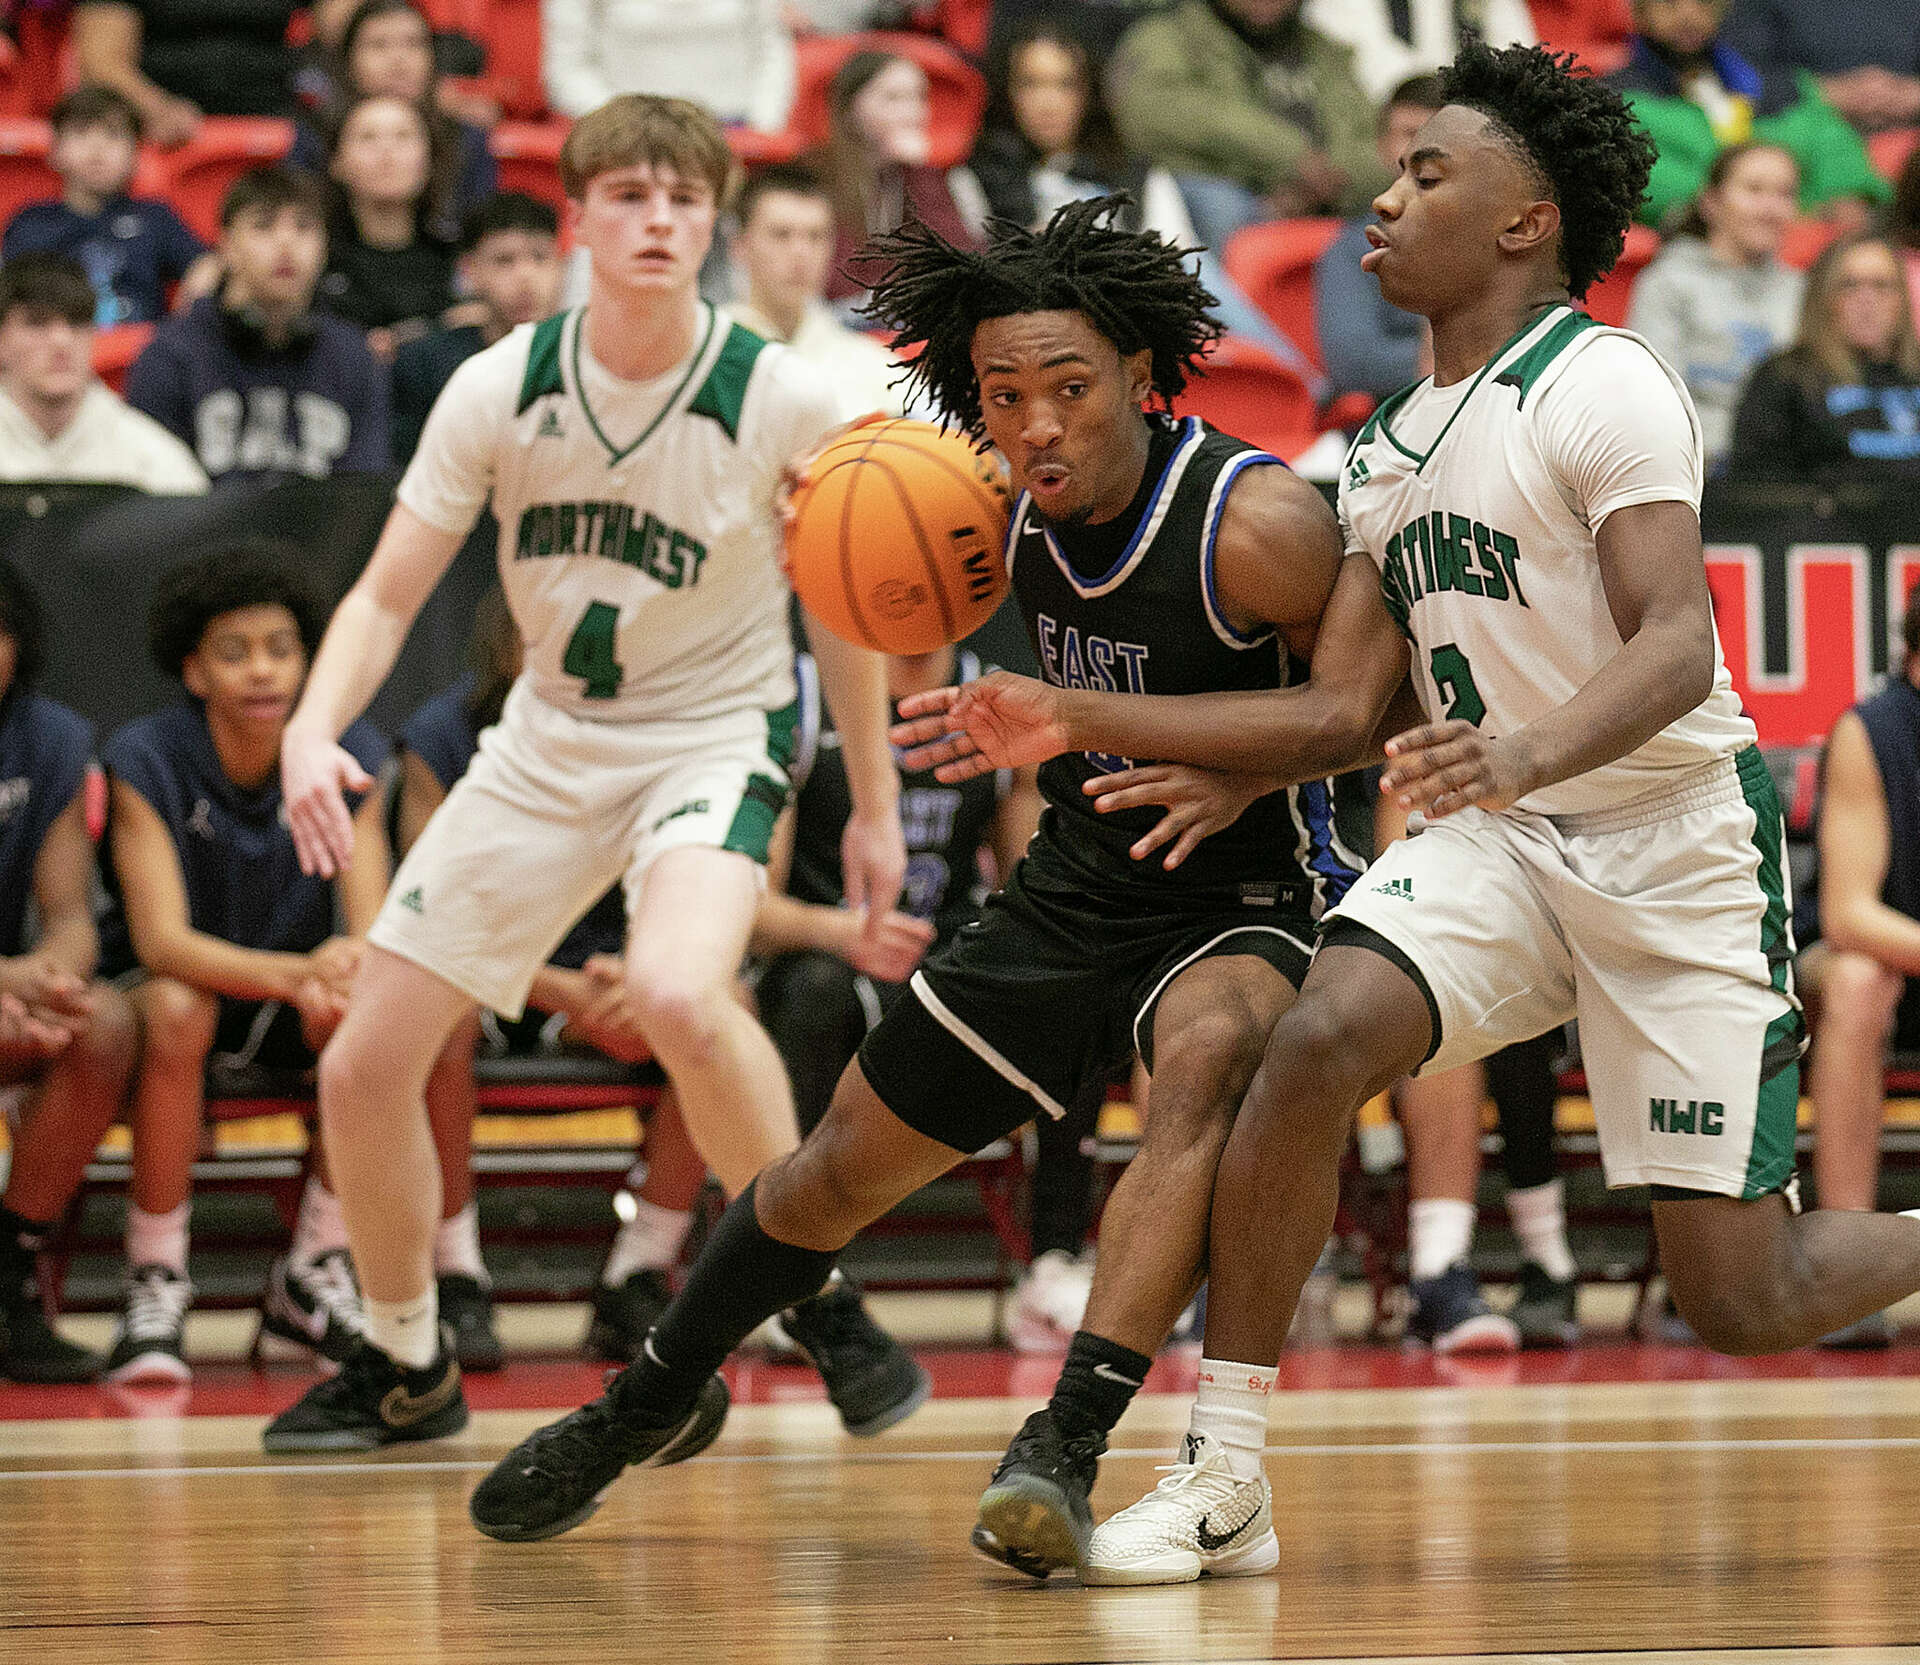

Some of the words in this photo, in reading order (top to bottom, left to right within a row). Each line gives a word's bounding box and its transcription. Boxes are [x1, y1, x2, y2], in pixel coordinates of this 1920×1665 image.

[515, 502, 707, 588] NORTHWEST
[562, 600, 624, 699] 4
[1038, 613, 1149, 694] EAST
[1650, 1098, 1724, 1136] NWC
